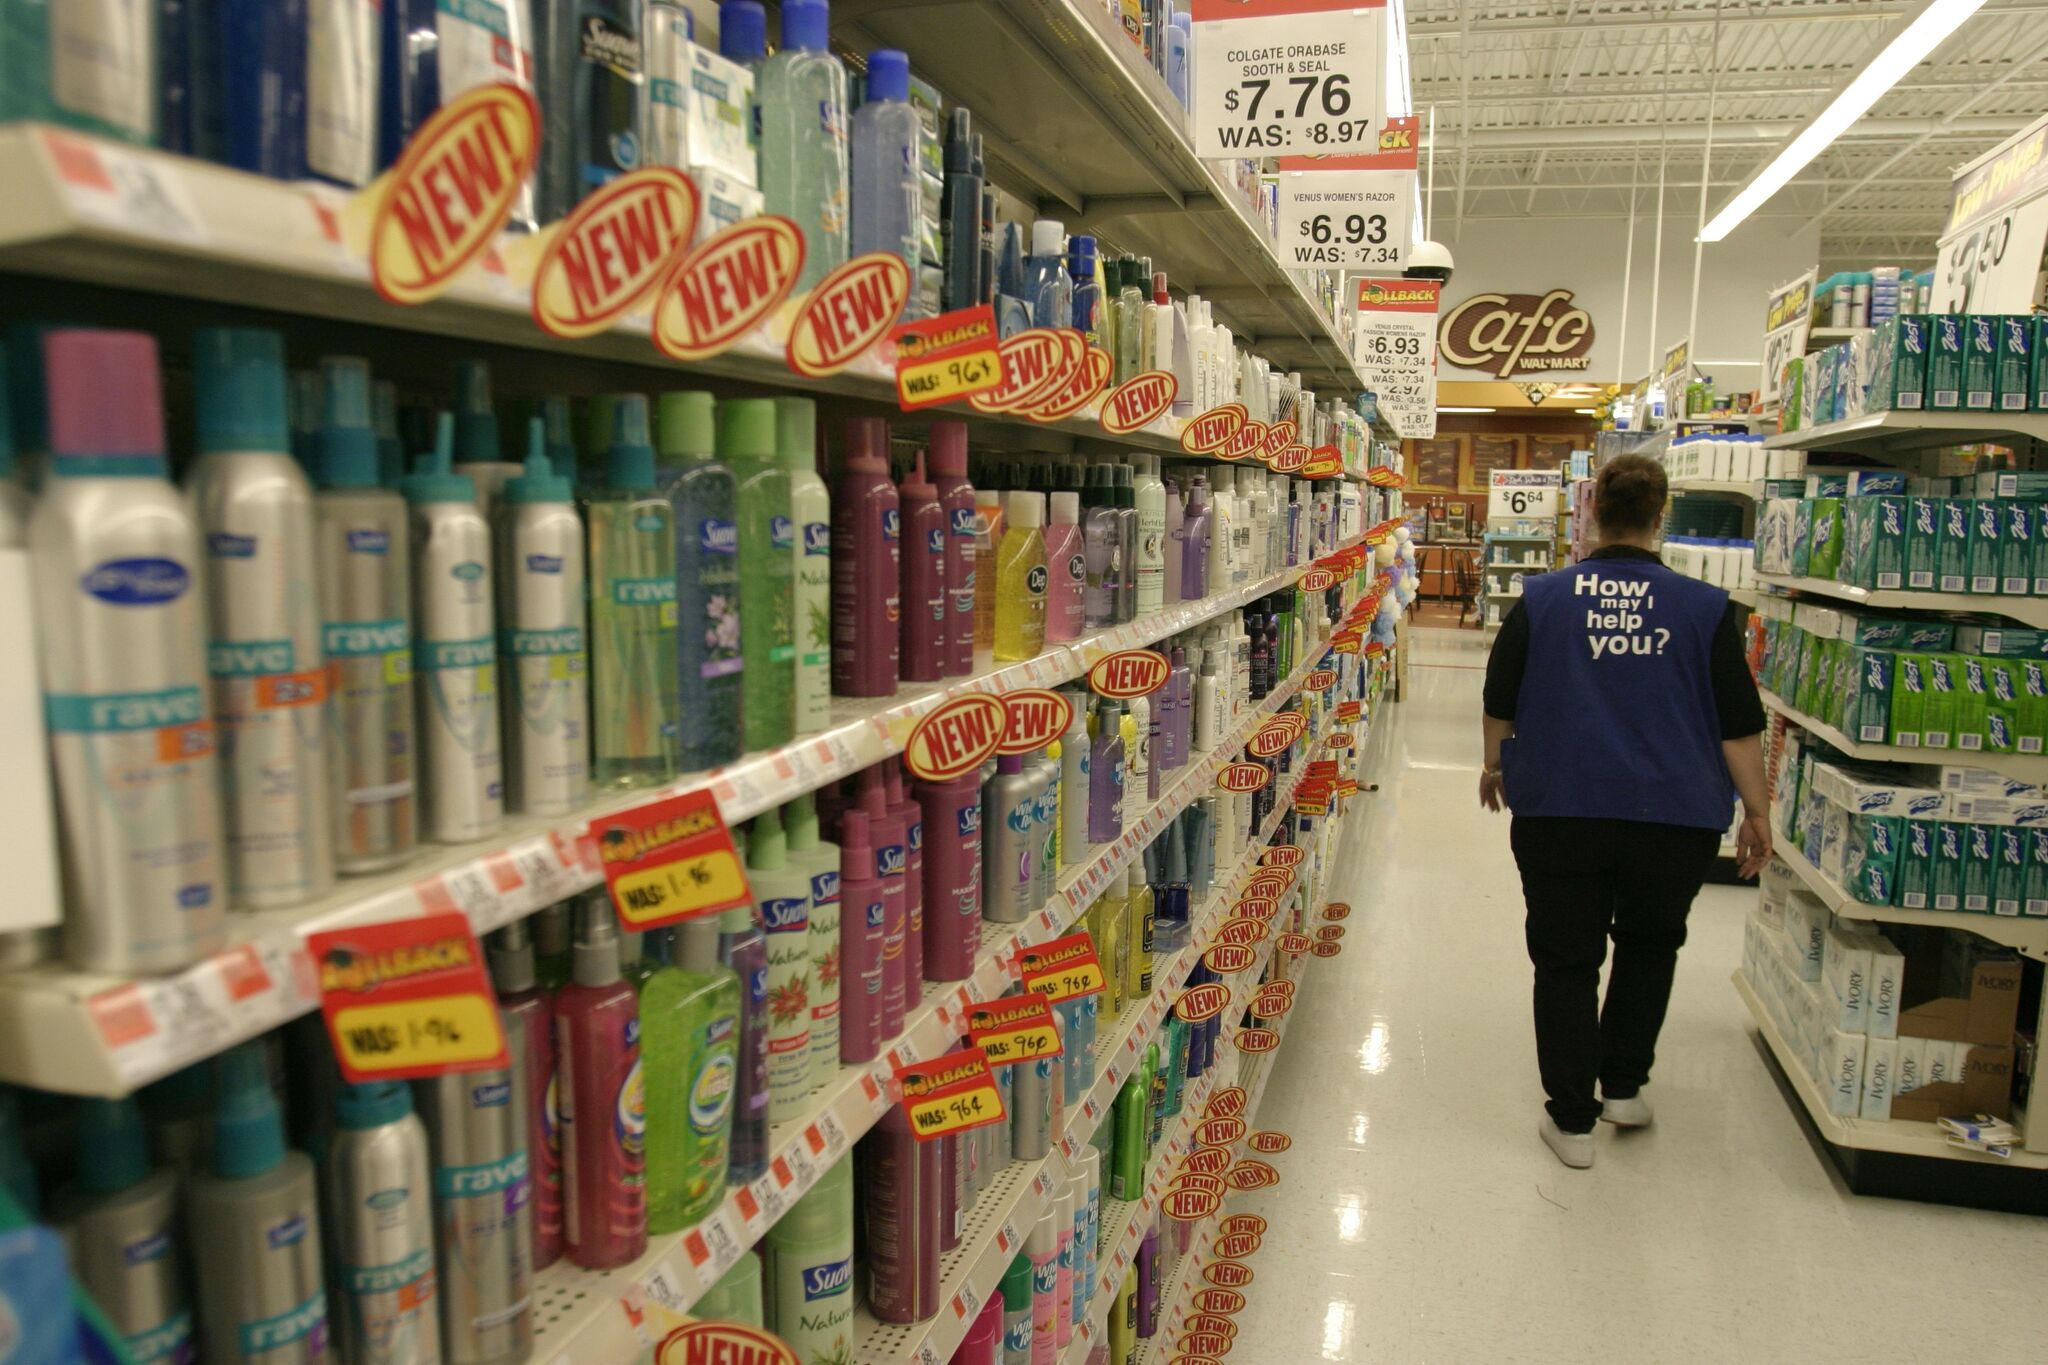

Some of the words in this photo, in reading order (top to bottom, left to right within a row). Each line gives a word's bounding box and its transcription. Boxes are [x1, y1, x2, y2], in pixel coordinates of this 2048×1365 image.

[1227, 47, 1285, 63] COLGATE
[1287, 43, 1346, 58] ORABASE
[1242, 64, 1284, 77] SOOTH
[1287, 63, 1295, 73] &
[1299, 60, 1331, 73] SEAL
[1224, 73, 1352, 122] $7.76
[1218, 123, 1293, 149] WAS:
[1305, 119, 1370, 145] $8.97
[392, 104, 522, 277] NEW!
[1294, 193, 1322, 202] VENUS
[1324, 192, 1364, 202] WOMEN'S
[1366, 192, 1396, 202] RAZOR
[1300, 214, 1388, 244] $6.93
[559, 185, 682, 322] NEW!
[1294, 247, 1346, 263] WAS:
[1354, 247, 1399, 263] $7.34
[675, 232, 787, 349] NEW!
[1361, 288, 1436, 303] ROLLBACK
[806, 267, 900, 362] NEW!
[1368, 336, 1420, 355] $6.93
[1902, 317, 1922, 353] Zest
[1940, 315, 1959, 352] Zest
[1974, 317, 1993, 353] Zest
[2008, 316, 2028, 354] Zest
[1365, 354, 1395, 365] WAS:
[1372, 375, 1398, 383] WAS:
[1114, 378, 1168, 427] NEW!
[1194, 415, 1236, 447] NEW!
[1261, 423, 1294, 456] NEW!
[1277, 450, 1309, 469] NEW!
[1823, 481, 1847, 494] Zes
[1864, 478, 1899, 491] Zest
[1881, 499, 1901, 535] Zest
[1914, 497, 1934, 534] Zest
[1945, 502, 1966, 539] Zest
[1977, 501, 1997, 539] Zest
[2008, 503, 2028, 540] Zest
[1032, 571, 1046, 589] Dep
[1072, 558, 1085, 575] Dep
[1575, 573, 1650, 597] How
[1600, 598, 1642, 611] may
[1648, 596, 1654, 609] I
[1587, 610, 1643, 633] help
[1588, 628, 1671, 660] you?
[1106, 660, 1160, 689] NEW!
[1310, 672, 1335, 689] NEW!
[1866, 655, 1885, 690] Zest
[1903, 656, 1923, 693] Zest
[1931, 654, 1951, 693] Zest
[1965, 658, 1985, 694] Zest
[2024, 660, 2045, 697] Zest
[924, 704, 997, 771] NEW!
[1258, 732, 1288, 751] NEW!
[1227, 769, 1264, 787] NEW!
[1872, 820, 1889, 855] Zest
[1911, 822, 1929, 858] Zest
[1941, 824, 1959, 860] Zest
[1971, 823, 1990, 860] Zest
[2002, 829, 2021, 865] Zest
[1271, 849, 1299, 863] NEW!
[1327, 906, 1346, 918] NEW!
[1283, 936, 1310, 949] NEW!
[1322, 929, 1342, 939] NEW!
[1214, 951, 1249, 969] NEW!
[1185, 993, 1223, 1016] NEW!
[1847, 970, 1865, 1011] IVORY
[1876, 976, 1895, 1017] IVORY
[1257, 998, 1287, 1013] NEW!
[1243, 1033, 1273, 1048] NEW!
[1839, 1055, 1856, 1096] IVORY
[1871, 1060, 1890, 1101] IVORY
[1204, 1122, 1239, 1143] NEW!
[1257, 1134, 1286, 1149] NEW!
[1174, 1194, 1212, 1214] NEW!
[1223, 1237, 1255, 1258] NEW!
[1215, 1266, 1248, 1283] NEW!
[1204, 1294, 1237, 1310] NEW!
[1189, 1339, 1225, 1354] NEW!
